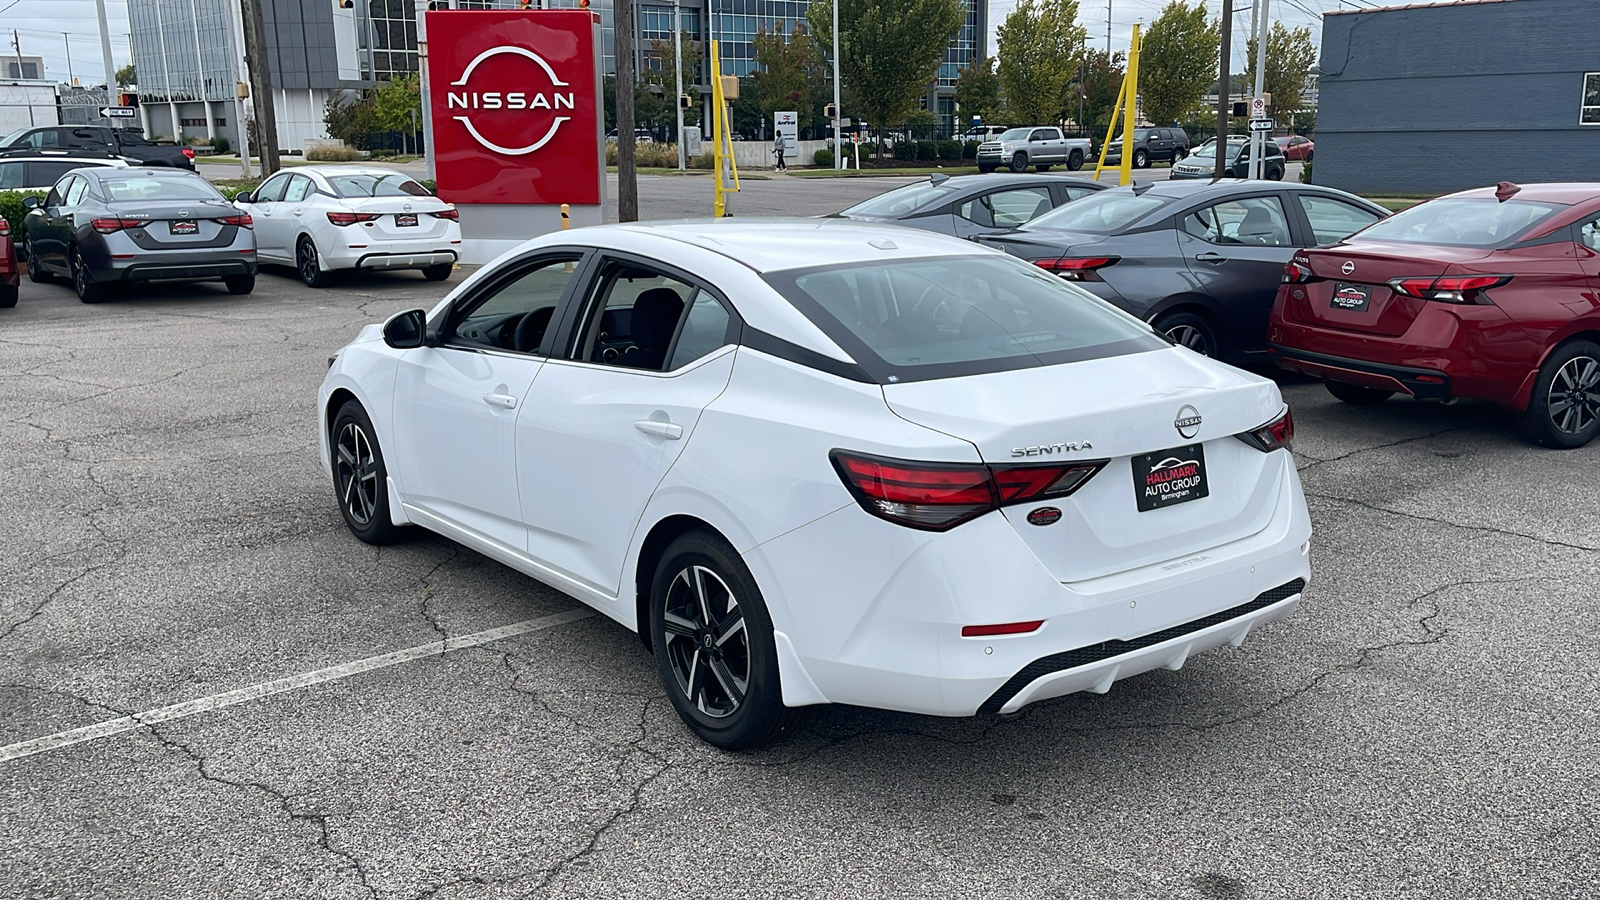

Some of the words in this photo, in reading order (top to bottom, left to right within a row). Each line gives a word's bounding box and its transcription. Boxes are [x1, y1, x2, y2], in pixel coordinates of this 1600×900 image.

[447, 92, 575, 110] NISSAN
[1010, 440, 1094, 458] SENTRA
[1145, 464, 1198, 486] HALLMARK
[1144, 481, 1171, 498] AUTO
[1170, 475, 1201, 493] GROUP
[1160, 488, 1190, 501] Birmingham
